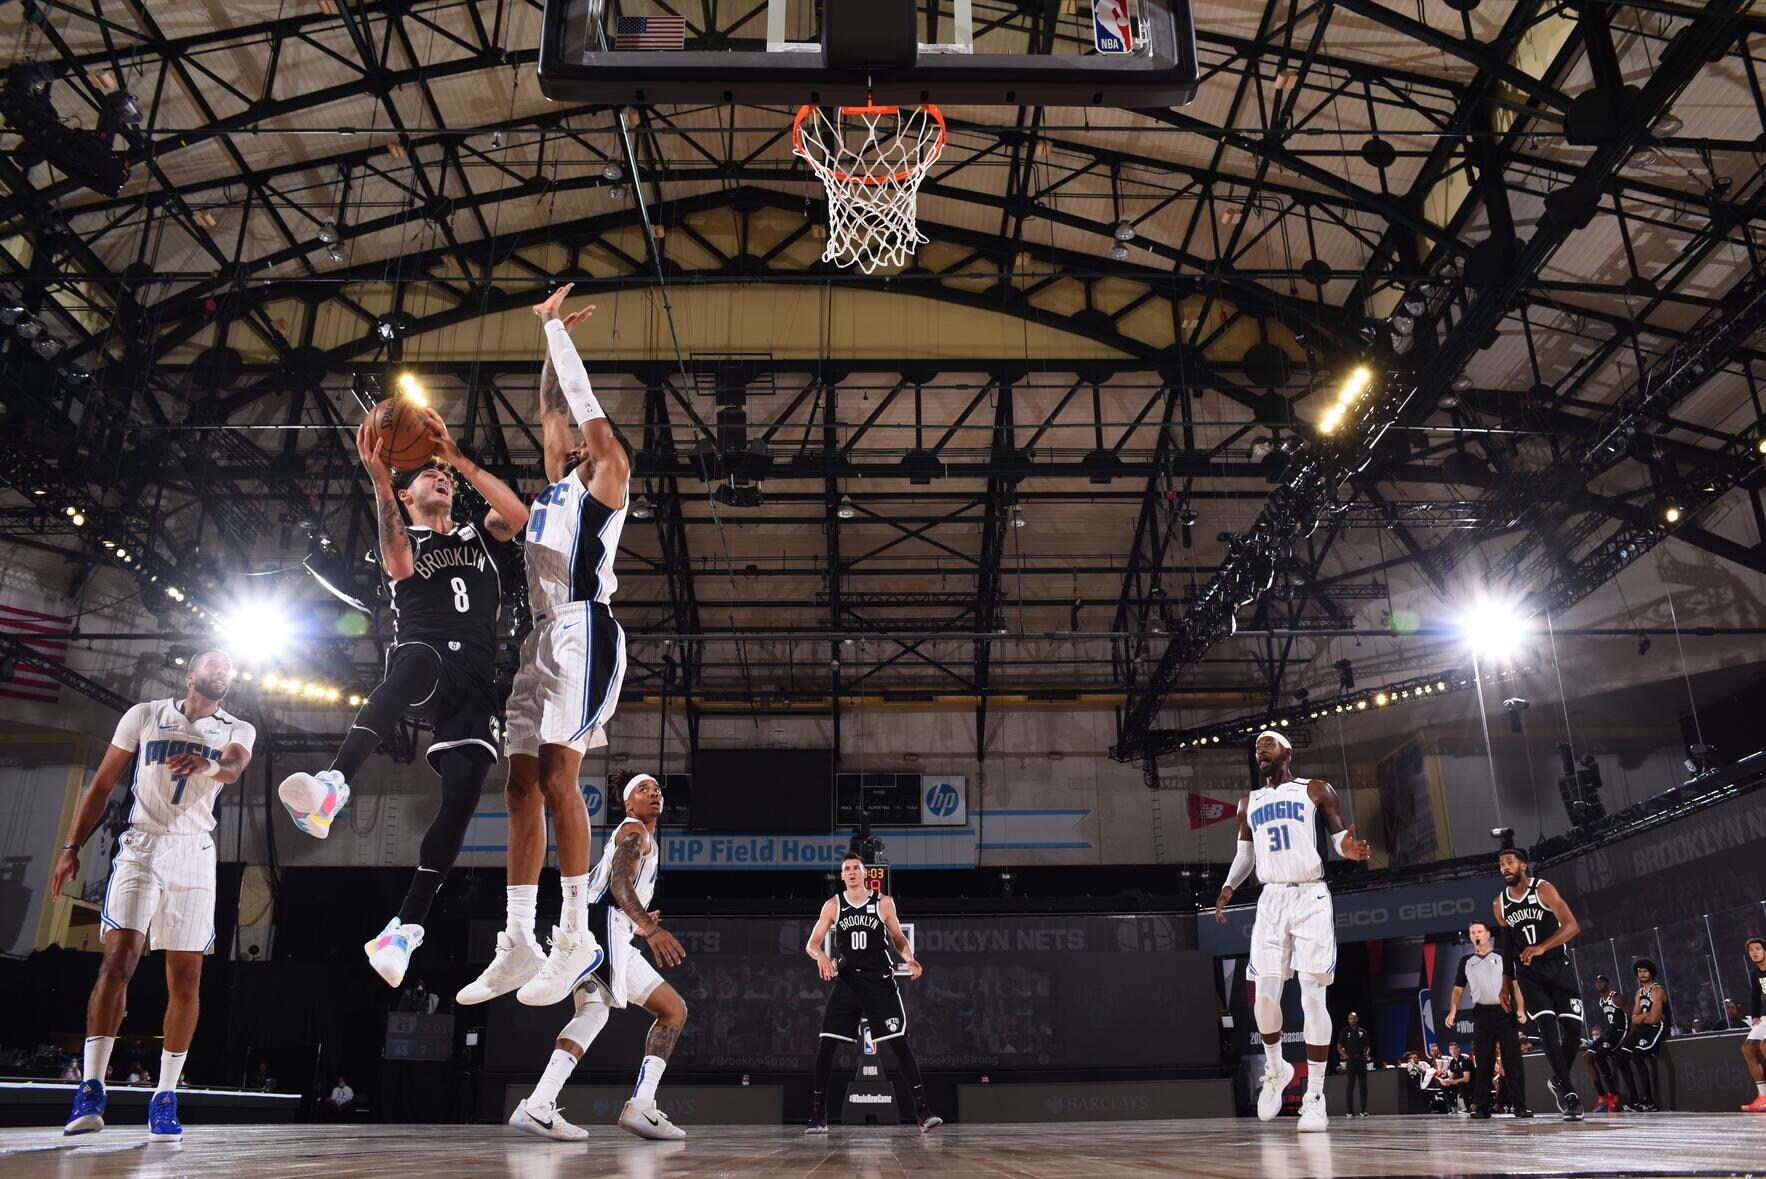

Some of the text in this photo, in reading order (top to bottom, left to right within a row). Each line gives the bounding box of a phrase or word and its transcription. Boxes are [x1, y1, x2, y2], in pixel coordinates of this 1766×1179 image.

[1101, 38, 1120, 50] NBA
[413, 546, 486, 580] BROOKLYN
[450, 577, 470, 612] 8
[171, 774, 189, 804] 7
[929, 784, 958, 816] hp
[1251, 800, 1305, 832] MAGIC
[1266, 825, 1291, 852] 31
[1632, 814, 1745, 876] BROOKLYN
[668, 839, 851, 863] HP Field Hous
[866, 868, 884, 879] :03
[839, 914, 880, 931] BROOKLYN
[1335, 897, 1475, 929] EICO GEICO
[671, 931, 721, 953] ETS
[851, 930, 867, 950] 00
[1016, 928, 1085, 952] NETS
[1522, 924, 1537, 945] 17
[915, 1055, 999, 1067] BrooklynStrong
[1067, 1096, 1148, 1112] BARCLAYS
